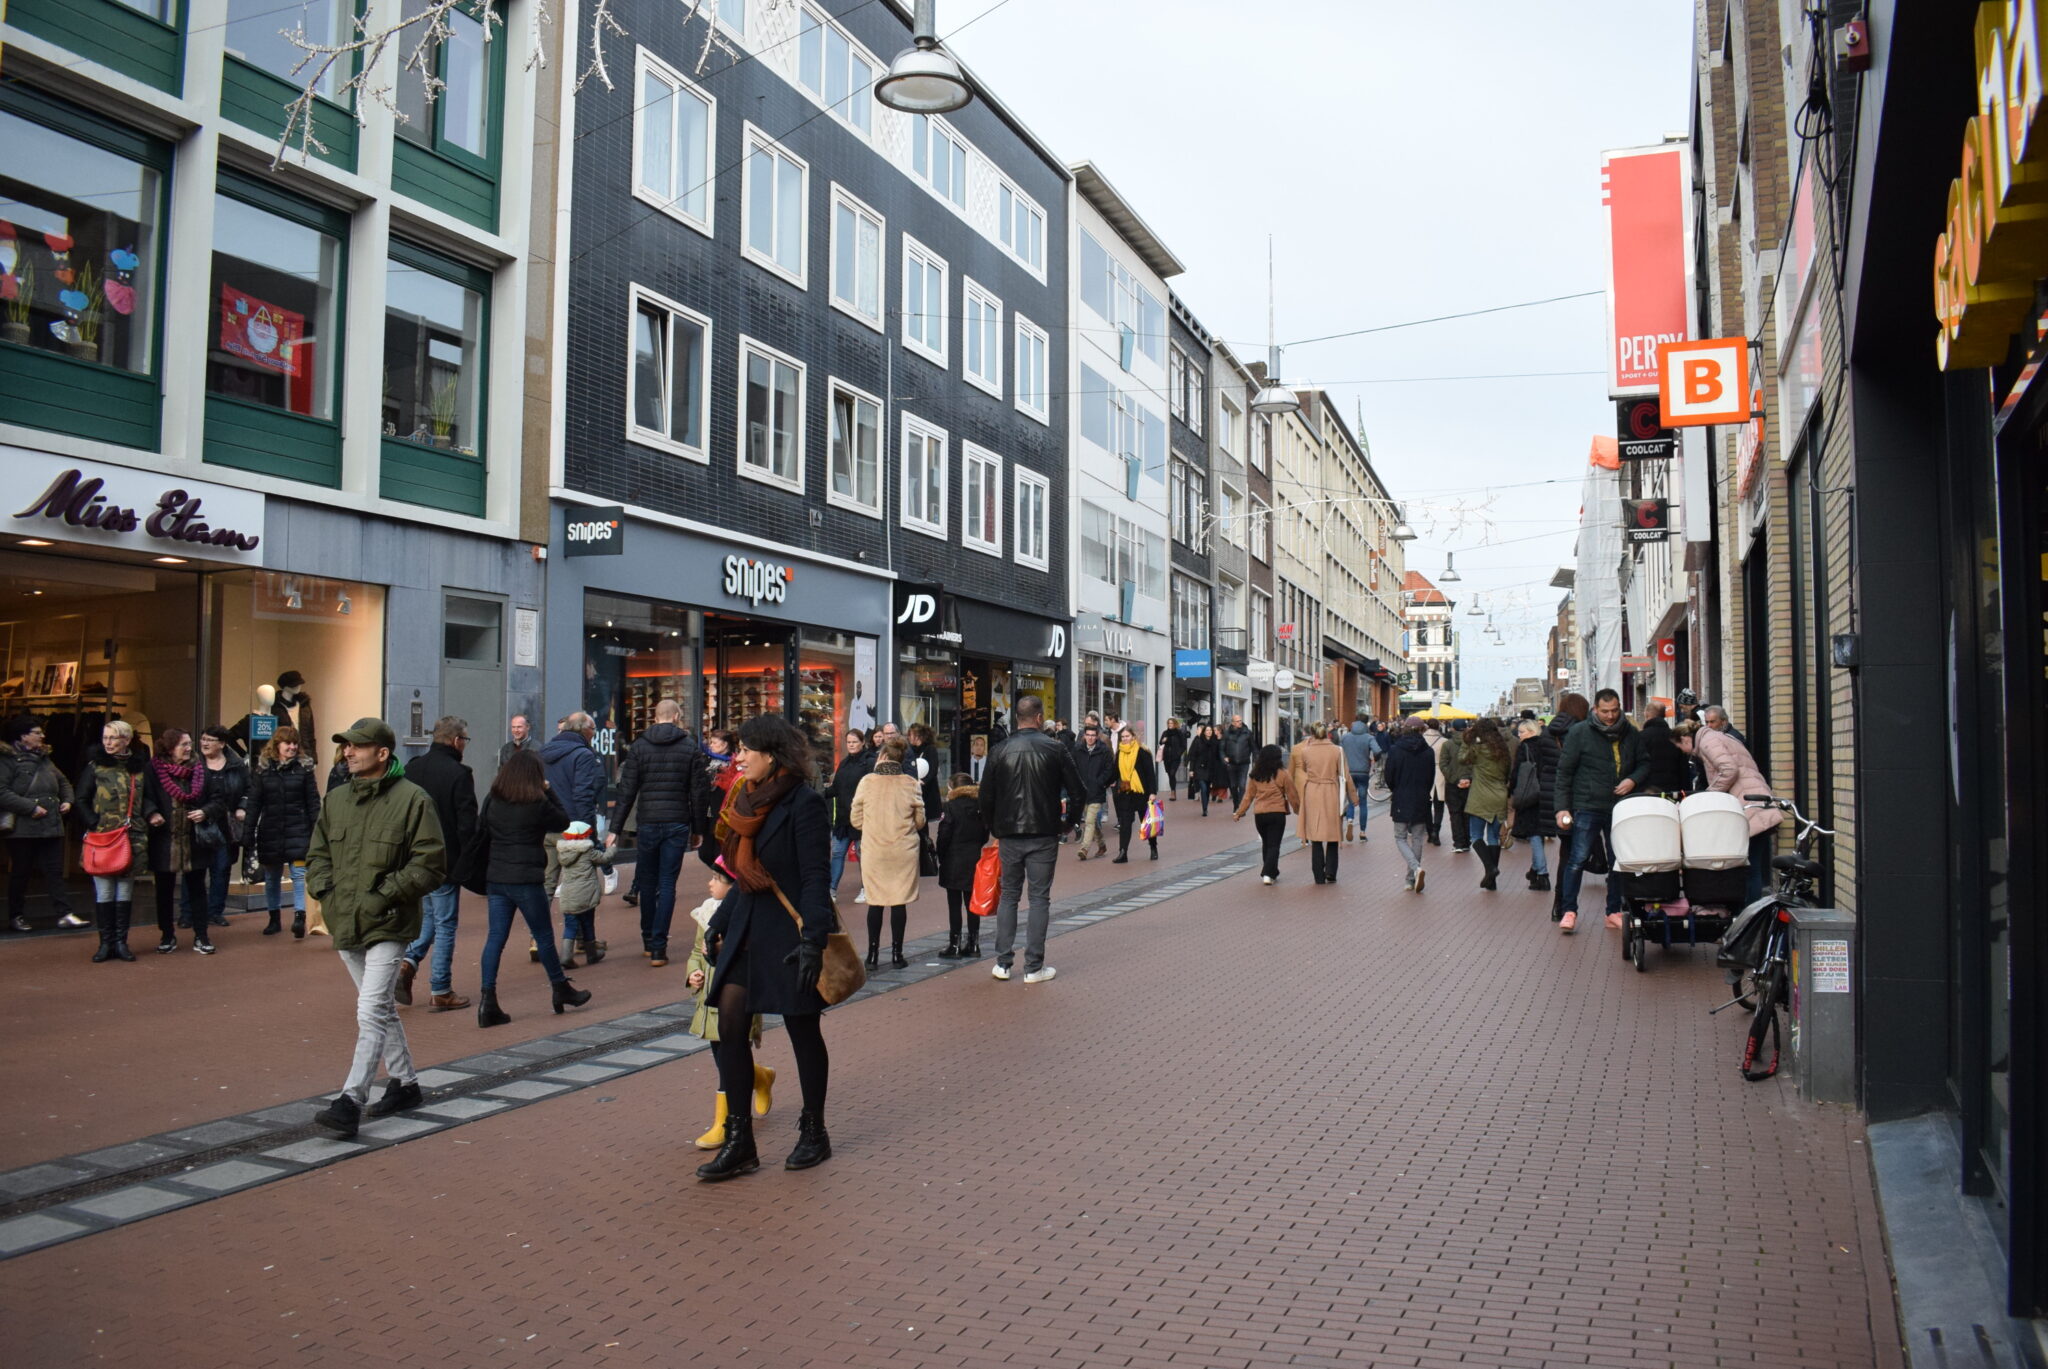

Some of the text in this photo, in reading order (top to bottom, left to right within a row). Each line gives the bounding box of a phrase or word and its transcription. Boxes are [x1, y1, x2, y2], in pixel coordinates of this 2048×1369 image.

[1619, 332, 1684, 372] PER
[1683, 358, 1723, 405] B
[1625, 444, 1666, 456] COOLCAT
[12, 469, 260, 551] Miss Etam
[567, 521, 612, 544] snipes
[1633, 531, 1663, 540] COOLCAT
[725, 554, 786, 607] snipes
[897, 594, 936, 624] JD
[1047, 624, 1066, 658] JD
[1103, 630, 1133, 654] VILA
